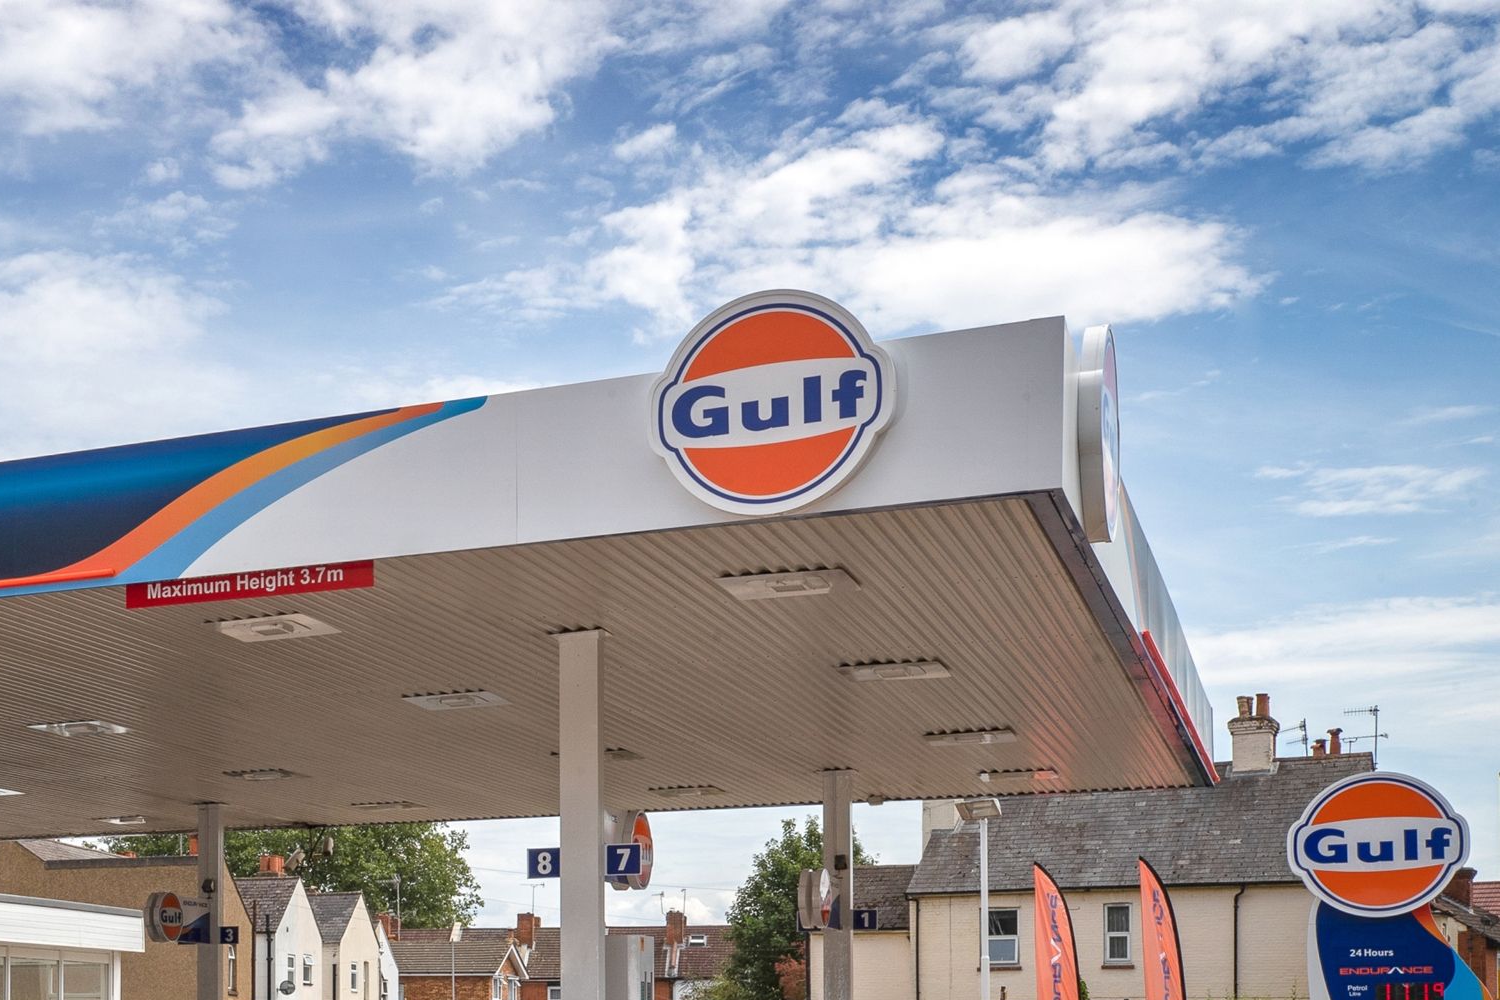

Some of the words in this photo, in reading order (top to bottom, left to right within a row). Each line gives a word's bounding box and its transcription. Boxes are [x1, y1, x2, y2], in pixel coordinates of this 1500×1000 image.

[671, 369, 867, 439] Gulf
[146, 577, 230, 600] Maximum
[236, 568, 295, 592] Height
[299, 566, 344, 585] 3.7m
[1303, 827, 1453, 864] Gulf
[537, 851, 552, 875] 8
[616, 848, 631, 871] 7
[160, 909, 181, 924] Gulf
[860, 911, 870, 928] 1
[224, 928, 234, 942] 3
[1349, 948, 1362, 957] 24
[1364, 948, 1394, 957] Hours
[1338, 965, 1434, 976] ENDURANCE
